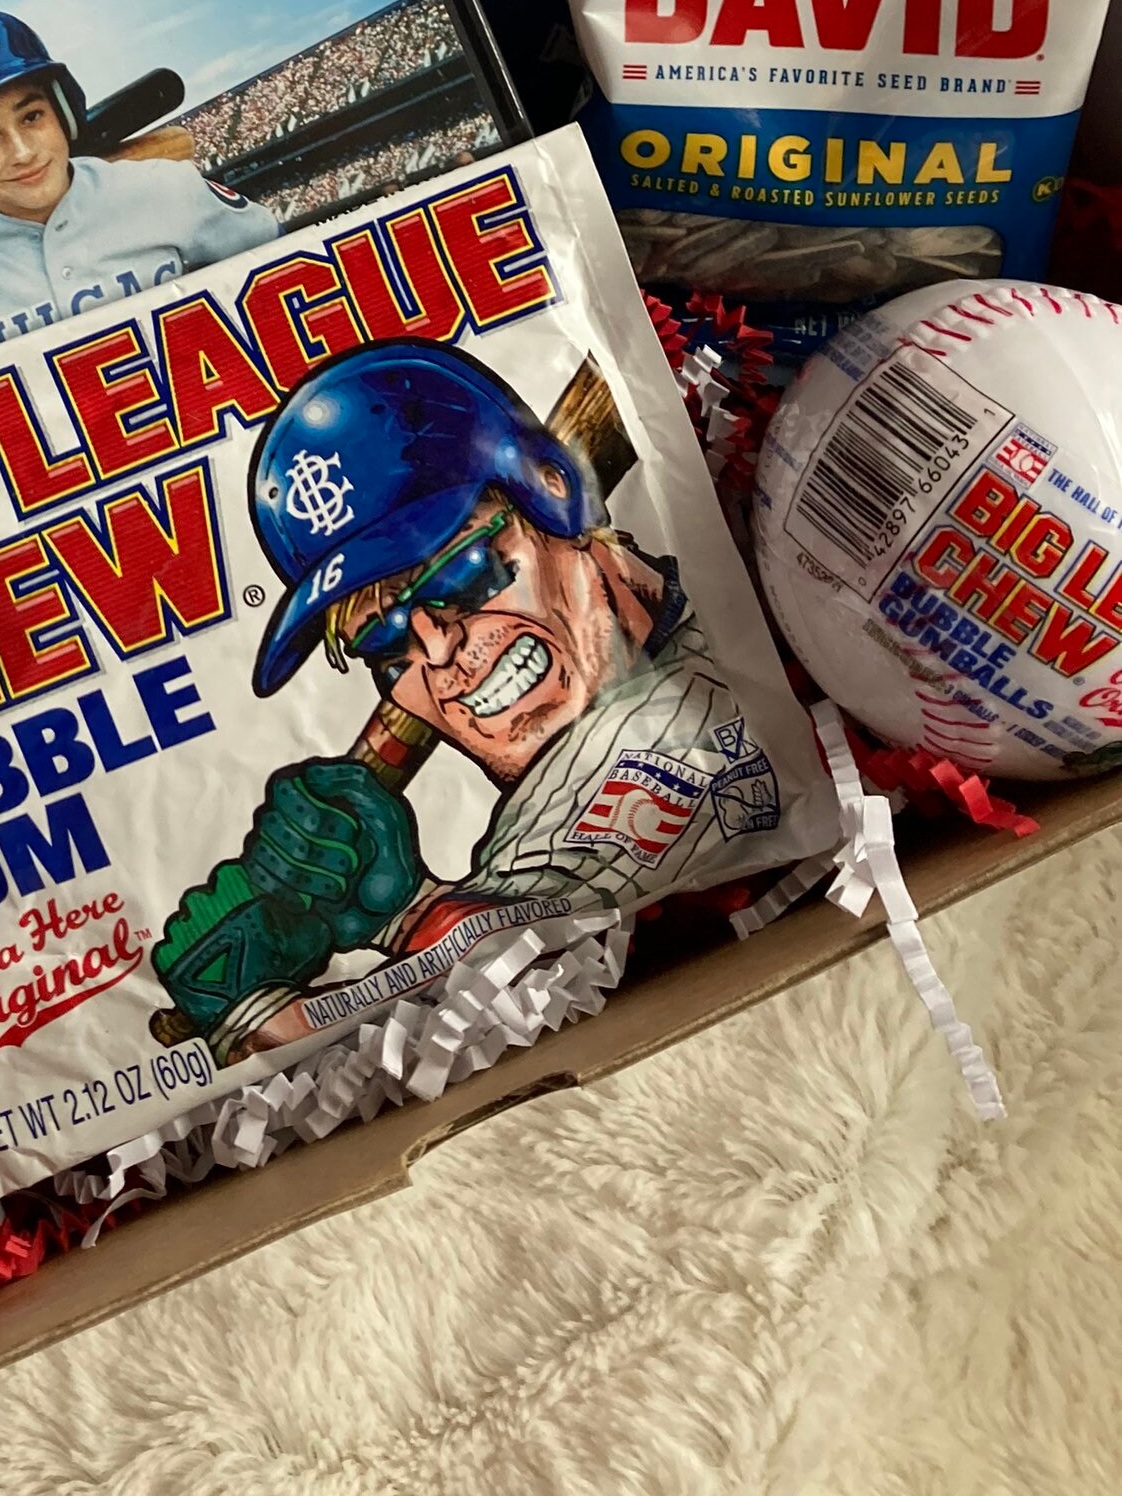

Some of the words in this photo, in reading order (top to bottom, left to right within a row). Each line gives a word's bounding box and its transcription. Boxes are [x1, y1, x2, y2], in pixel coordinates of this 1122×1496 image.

[655, 64, 759, 84] AMERICA'S
[769, 68, 865, 88] FAVORITE
[877, 72, 928, 92] SEED
[939, 75, 1009, 95] BRAND
[619, 129, 1013, 186] ORIGINAL
[630, 173, 700, 194] SALTED
[709, 181, 721, 197] &
[731, 185, 815, 206] ROASTED
[824, 187, 936, 207] SUNFLOWER
[944, 186, 1001, 205] SEEDS
[873, 496, 917, 558] 42897
[917, 433, 970, 495] 66043
[945, 463, 1075, 580] BIG
[1047, 468, 1074, 494] THE
[1070, 485, 1102, 515] HALL
[1100, 506, 1119, 524] OF
[306, 553, 345, 605] 16
[911, 524, 1122, 680] CHEW
[890, 571, 1017, 670] BUBBLE
[877, 593, 1055, 720] GUMBALLS
[608, 767, 696, 810] BASEBALL
[623, 752, 710, 788] NATIONAL
[711, 764, 745, 791] PEANUT
[744, 758, 770, 776] FREE
[615, 830, 632, 845] OF
[18, 890, 127, 952] Here
[305, 977, 385, 1028] NATURALLY
[385, 962, 418, 995] AND
[418, 914, 493, 980] ARTIFICIALLY
[497, 897, 573, 928] FLAVORED
[18, 1094, 62, 1141] WT
[62, 1080, 117, 1126] 2.12
[115, 1064, 154, 1107] OZ
[151, 1041, 215, 1103] (60g)
